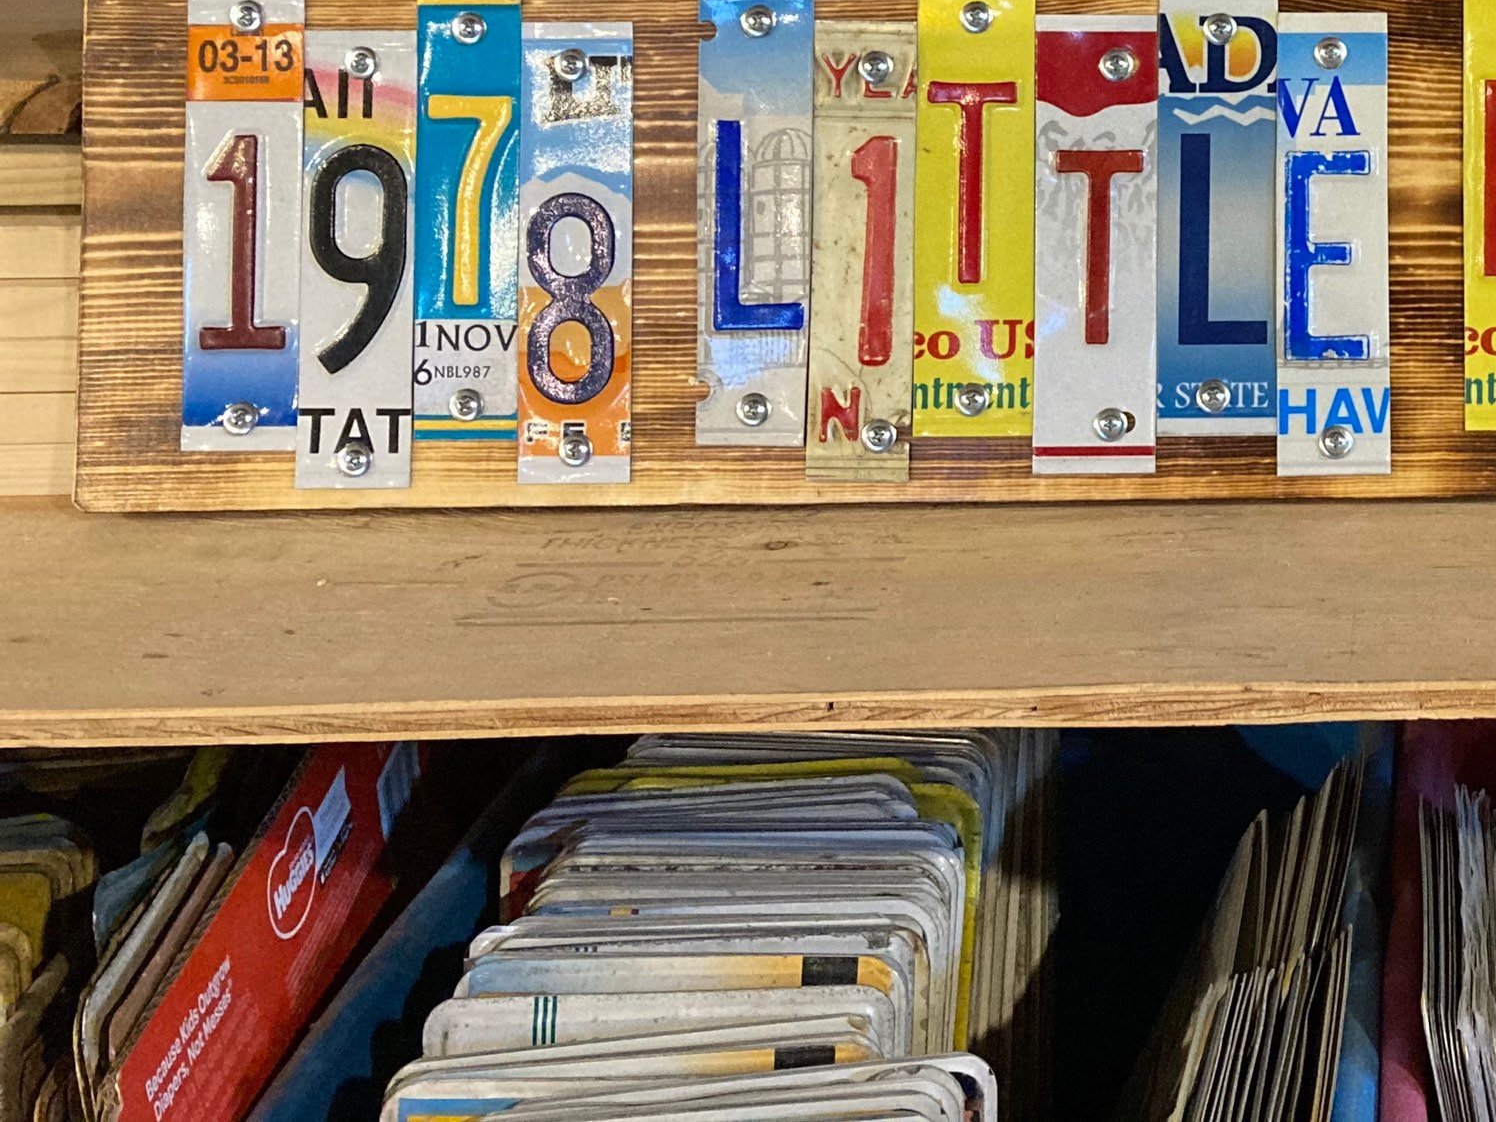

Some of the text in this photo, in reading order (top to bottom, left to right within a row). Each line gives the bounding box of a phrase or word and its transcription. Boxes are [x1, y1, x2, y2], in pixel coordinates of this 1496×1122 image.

[198, 39, 294, 74] 03-13
[1158, 13, 1277, 93] AD
[199, 95, 617, 405] 1978
[296, 408, 412, 455] TAT
[145, 1038, 182, 1102] Because
[179, 1007, 200, 1045] Kids
[198, 954, 231, 1014] Outgrow
[187, 1031, 205, 1066] Not
